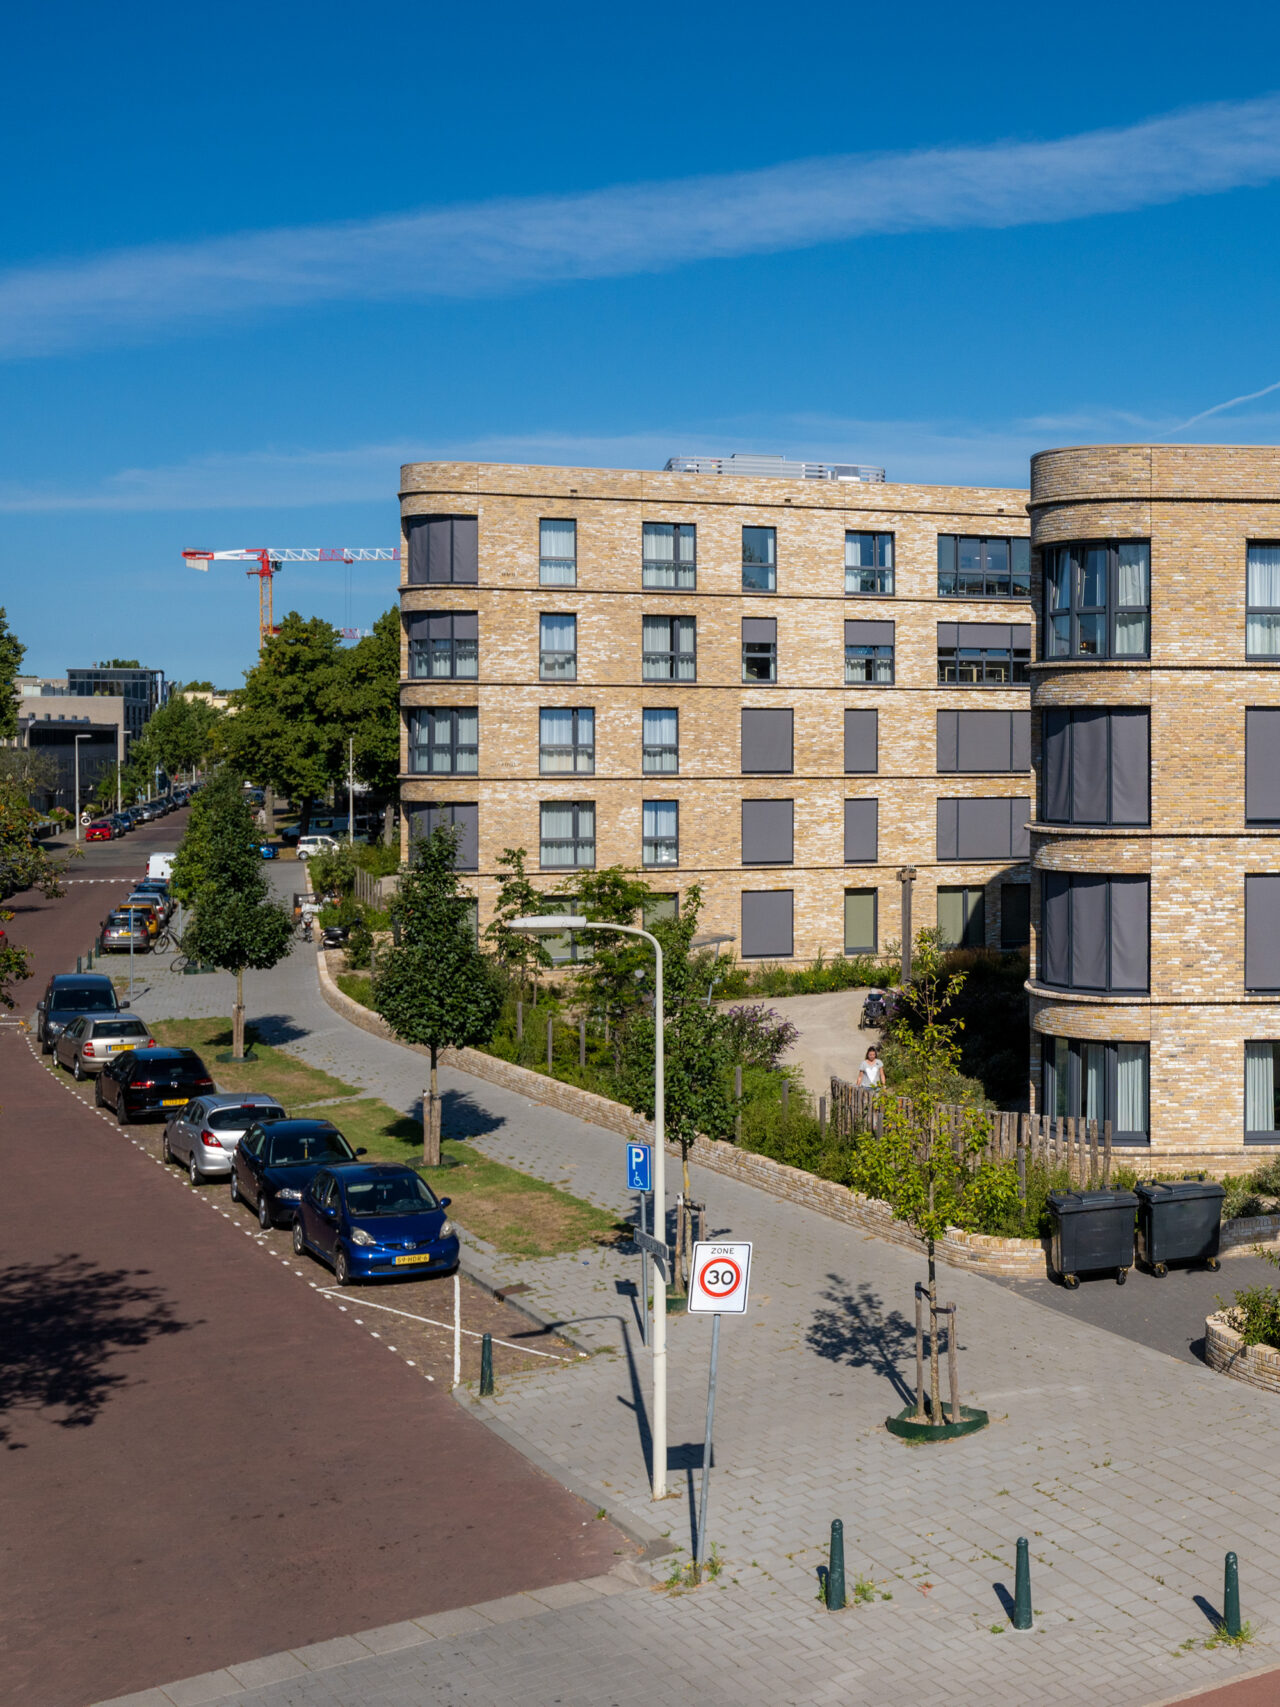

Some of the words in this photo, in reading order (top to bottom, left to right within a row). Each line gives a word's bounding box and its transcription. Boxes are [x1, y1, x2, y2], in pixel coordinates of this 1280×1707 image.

[632, 1148, 644, 1170] P
[710, 1247, 735, 1255] ZONE
[707, 1270, 734, 1286] 30
